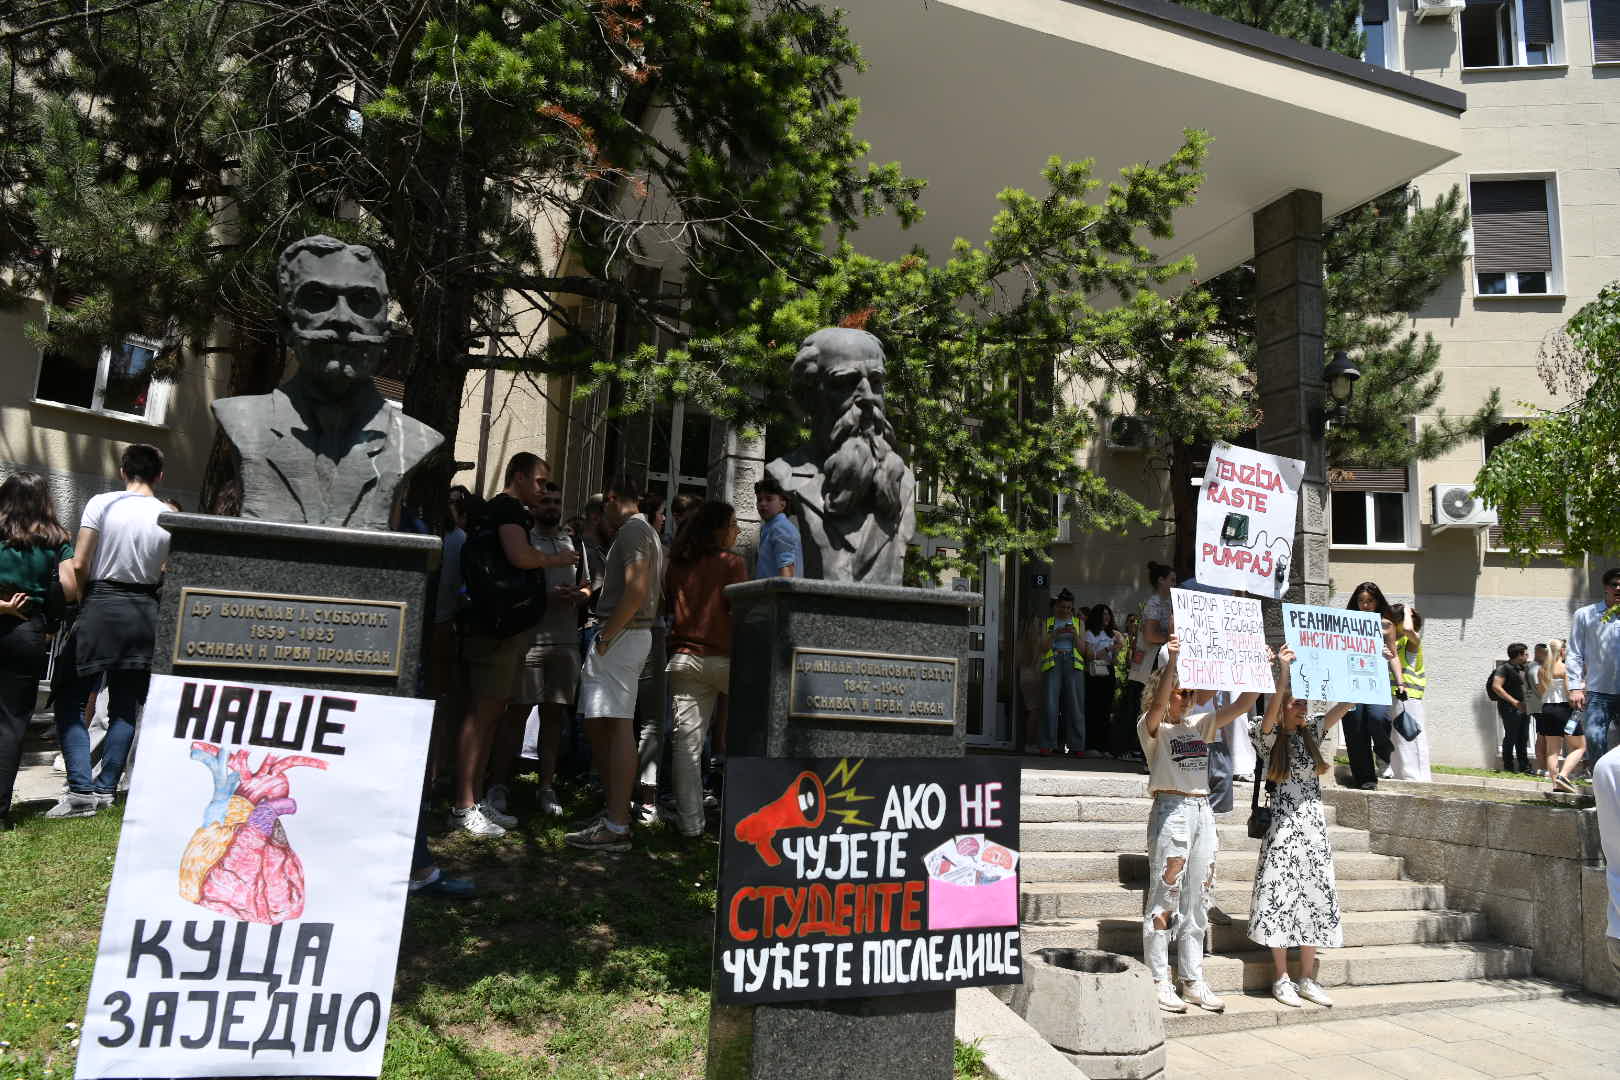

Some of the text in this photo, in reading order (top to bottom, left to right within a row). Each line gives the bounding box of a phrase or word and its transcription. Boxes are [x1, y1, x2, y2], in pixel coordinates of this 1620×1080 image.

[1206, 481, 1268, 513] RASTE
[1215, 456, 1285, 494] TENZIJA
[1036, 575, 1044, 585] 8
[1202, 542, 1274, 577] PUMPAJ
[1289, 610, 1382, 637] РЕАНИМАЦИЈА
[1299, 630, 1377, 654] ИНСТИТУЦИЈА
[186, 641, 254, 659] ОСНИВАЧ
[273, 645, 311, 662] ПРВИ
[316, 646, 391, 667] ПРОДЕКАН
[173, 681, 358, 756] НАШЕ
[880, 781, 1004, 831] АКО НЕ
[783, 826, 909, 880] ЧУЈЕТЕ
[728, 881, 927, 942] СТУДЕНТЕ
[126, 919, 335, 1000] КУЦА
[721, 931, 1020, 993] ЧУЋЕТЕ ПОСЛЕДИЦЕ
[97, 990, 381, 1059] ЗАЈЕДНО
